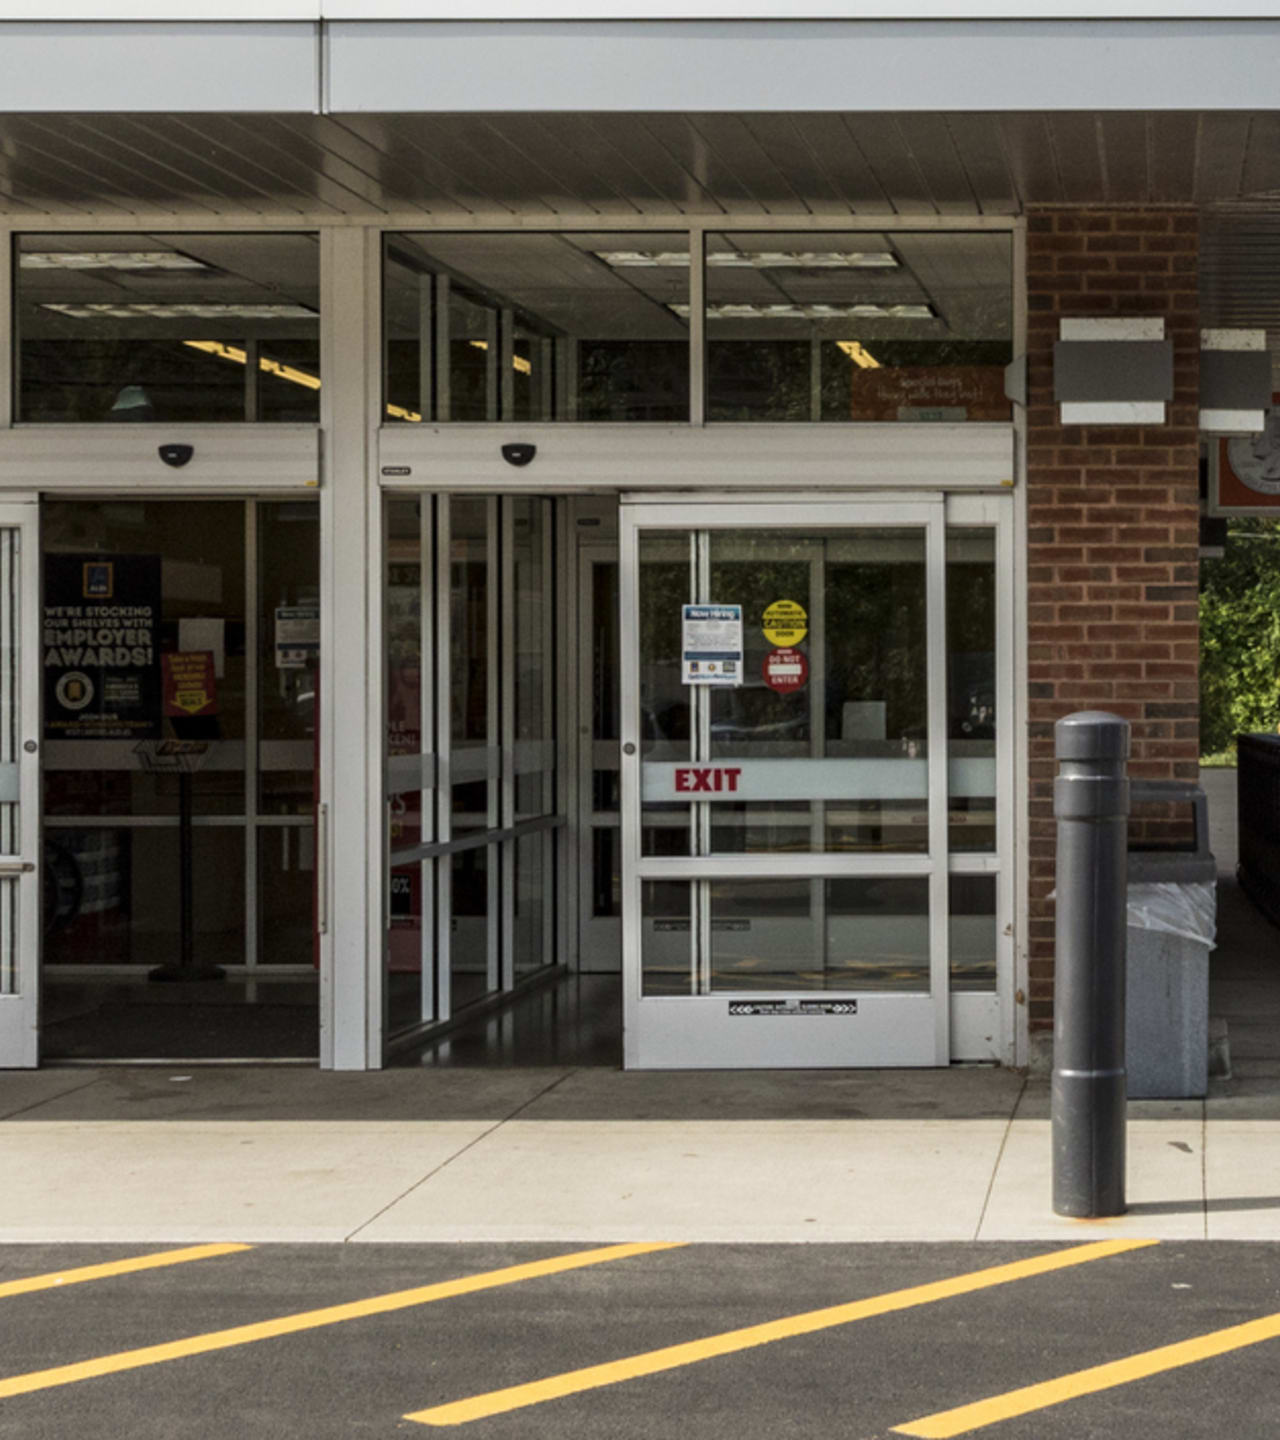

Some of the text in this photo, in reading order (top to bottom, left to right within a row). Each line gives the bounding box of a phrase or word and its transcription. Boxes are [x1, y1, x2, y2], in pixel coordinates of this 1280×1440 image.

[44, 606, 152, 617] WE'RE STOCKING
[44, 618, 153, 628] OUR SHELVES WITH
[44, 628, 152, 646] EMPLOYER
[44, 647, 153, 666] AWARDS!
[769, 654, 801, 664] DO NOT
[771, 676, 799, 684] ENTER
[675, 768, 742, 792] EXIT
